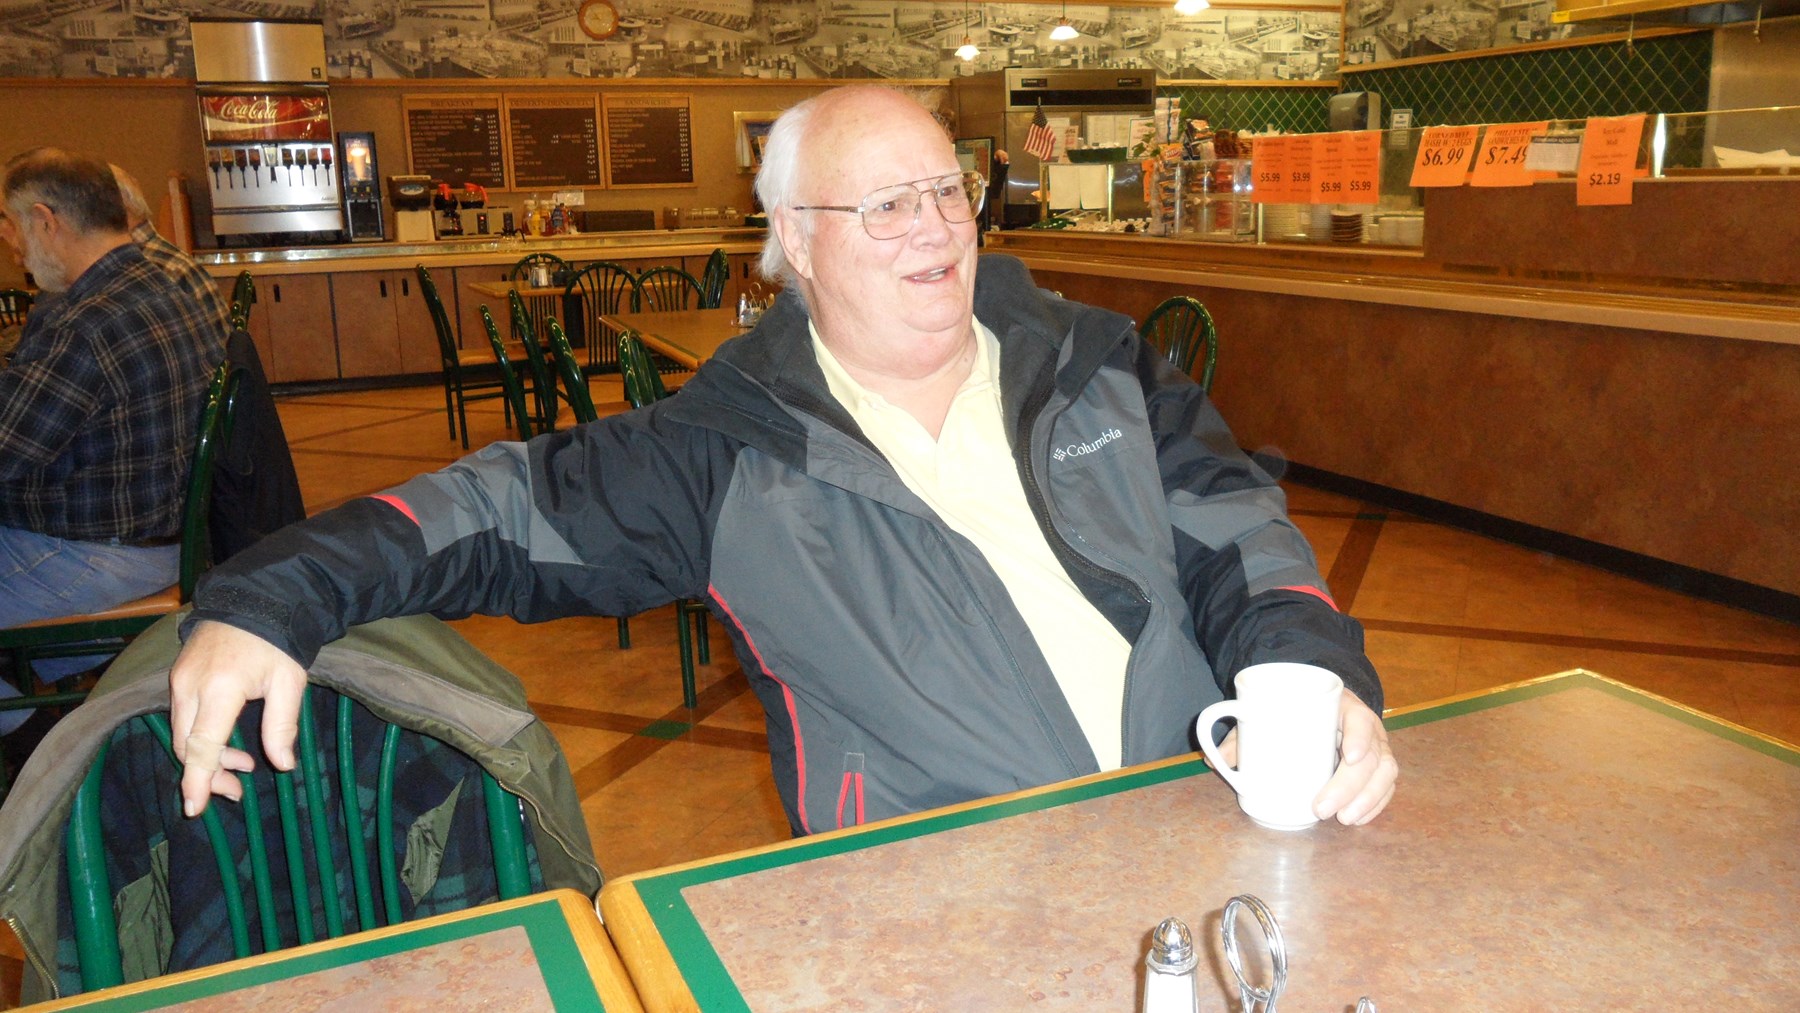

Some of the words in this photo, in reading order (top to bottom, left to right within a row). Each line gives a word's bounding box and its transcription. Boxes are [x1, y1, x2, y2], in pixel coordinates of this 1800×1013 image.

[221, 100, 278, 119] Coca-Cola
[1422, 147, 1464, 167] $6.99
[1260, 172, 1281, 182] $5.99
[1292, 172, 1311, 182] $3.99
[1589, 172, 1621, 187] $2.19
[1320, 182, 1341, 192] $5.99
[1350, 180, 1371, 191] $5.99
[1066, 428, 1123, 457] Columbia
